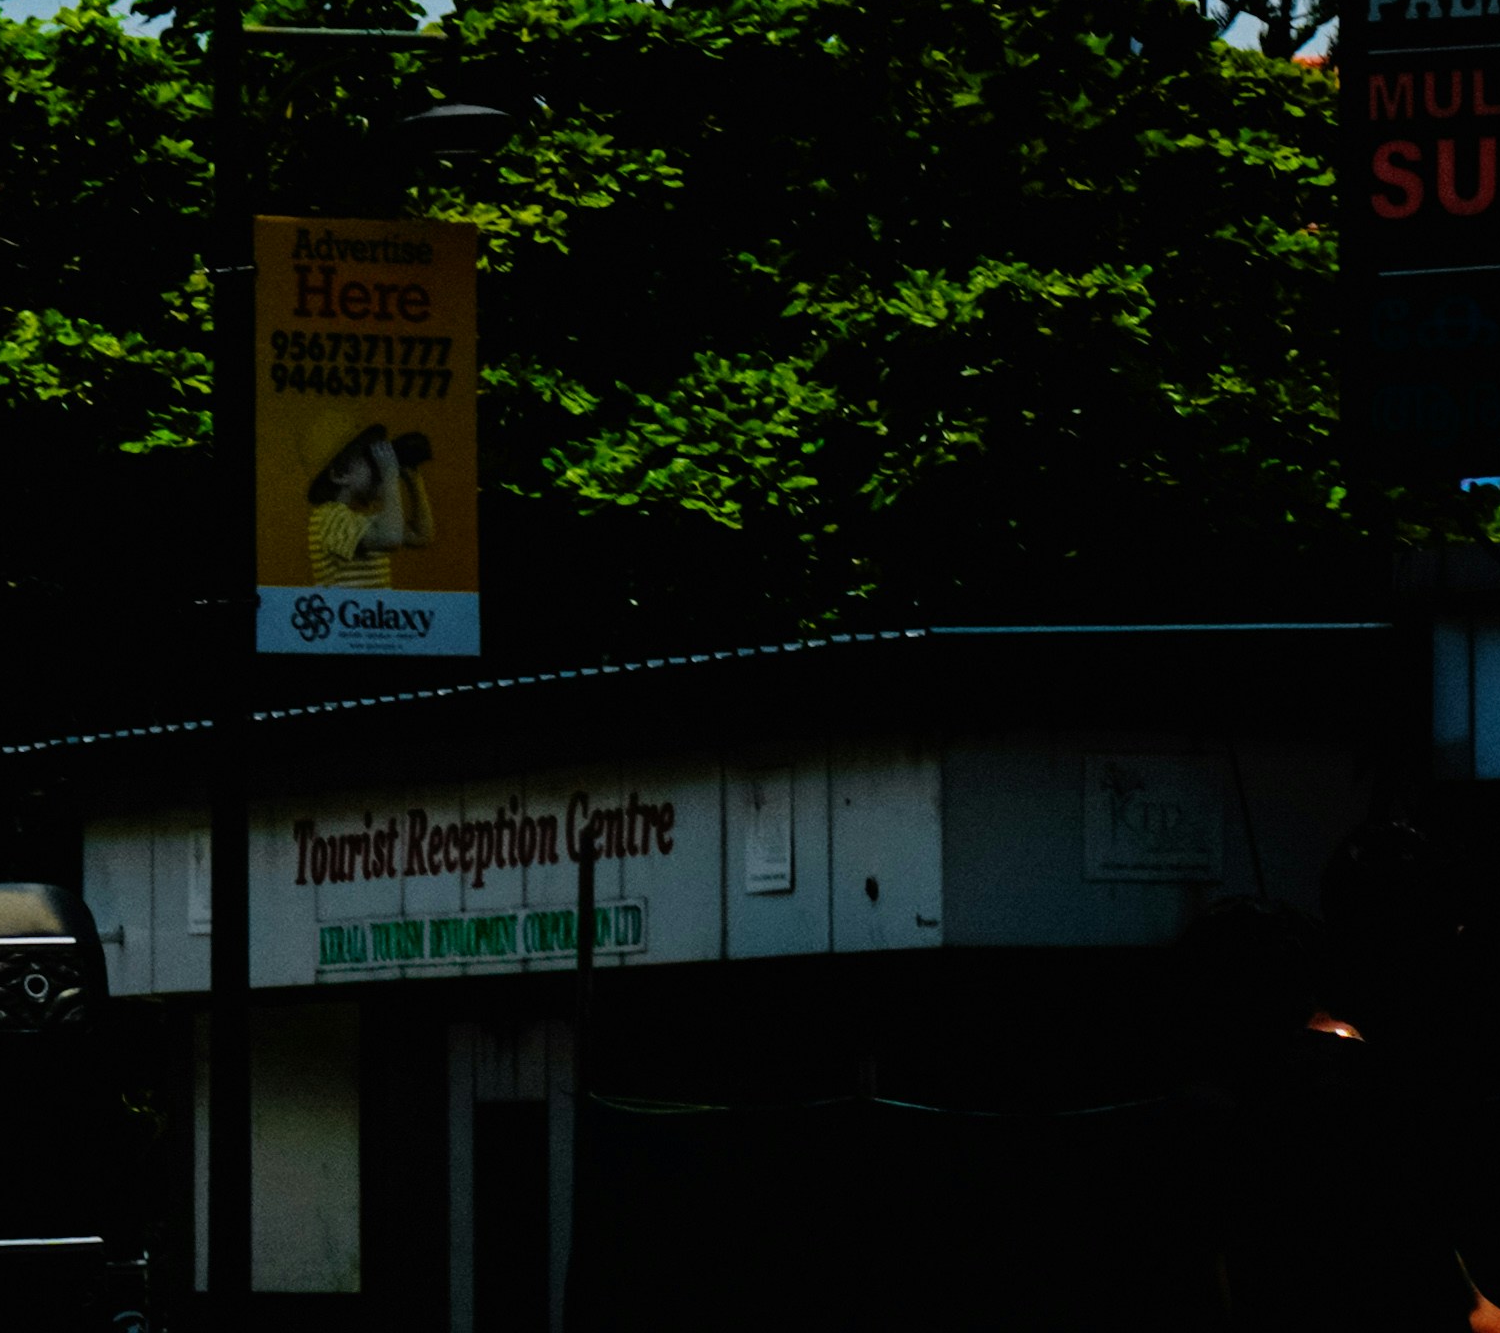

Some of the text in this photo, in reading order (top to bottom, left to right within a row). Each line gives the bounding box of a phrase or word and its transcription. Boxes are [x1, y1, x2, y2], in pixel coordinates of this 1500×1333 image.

[292, 228, 434, 265] Advertise
[293, 264, 431, 323] Here
[271, 329, 452, 367] 9567371777
[271, 364, 453, 399] 9446371777
[337, 599, 436, 638] Galaxy
[293, 790, 675, 890] Tourist Reception Centre
[319, 925, 368, 966] KERALA
[370, 919, 425, 962] TOURISM
[614, 904, 642, 946] LTD
